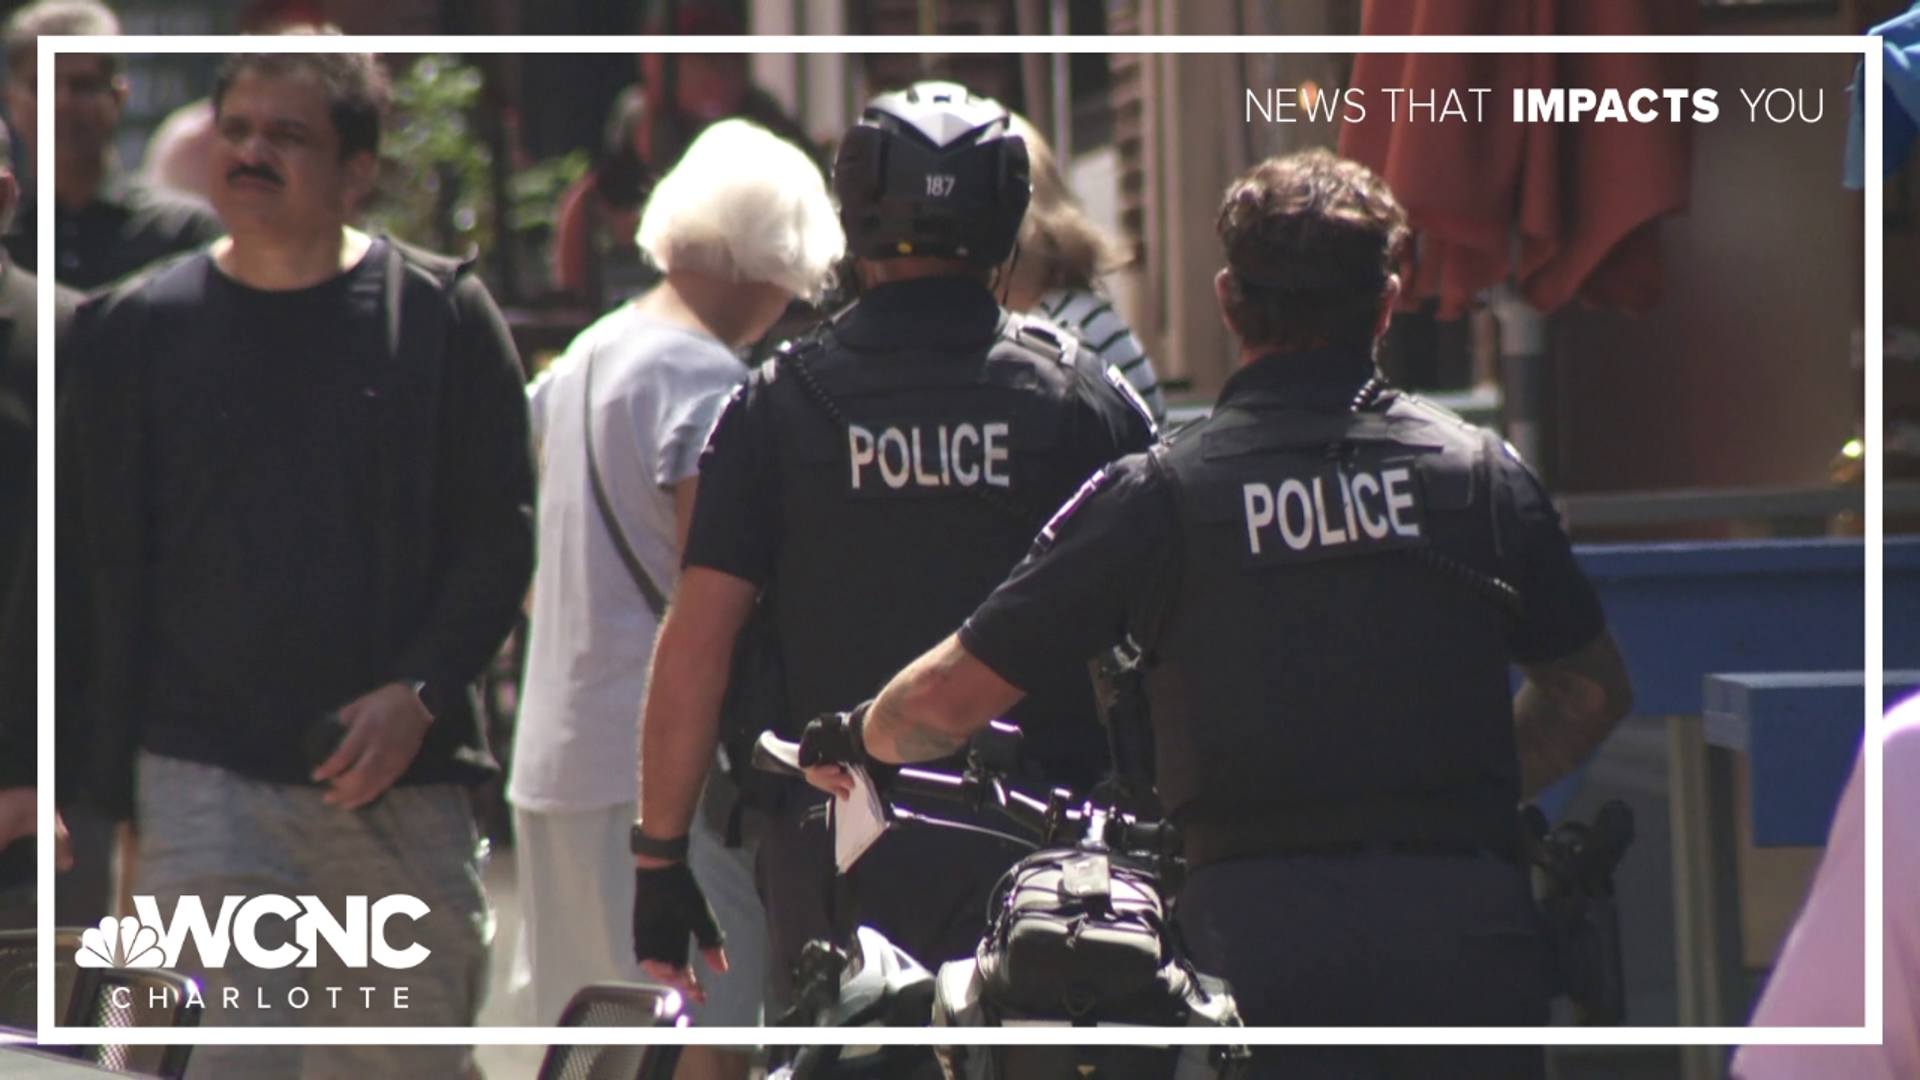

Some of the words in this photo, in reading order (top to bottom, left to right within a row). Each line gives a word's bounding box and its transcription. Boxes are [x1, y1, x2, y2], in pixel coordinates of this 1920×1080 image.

[925, 174, 955, 197] 187
[849, 422, 1010, 489] POLICE
[1243, 468, 1420, 554] POLICE
